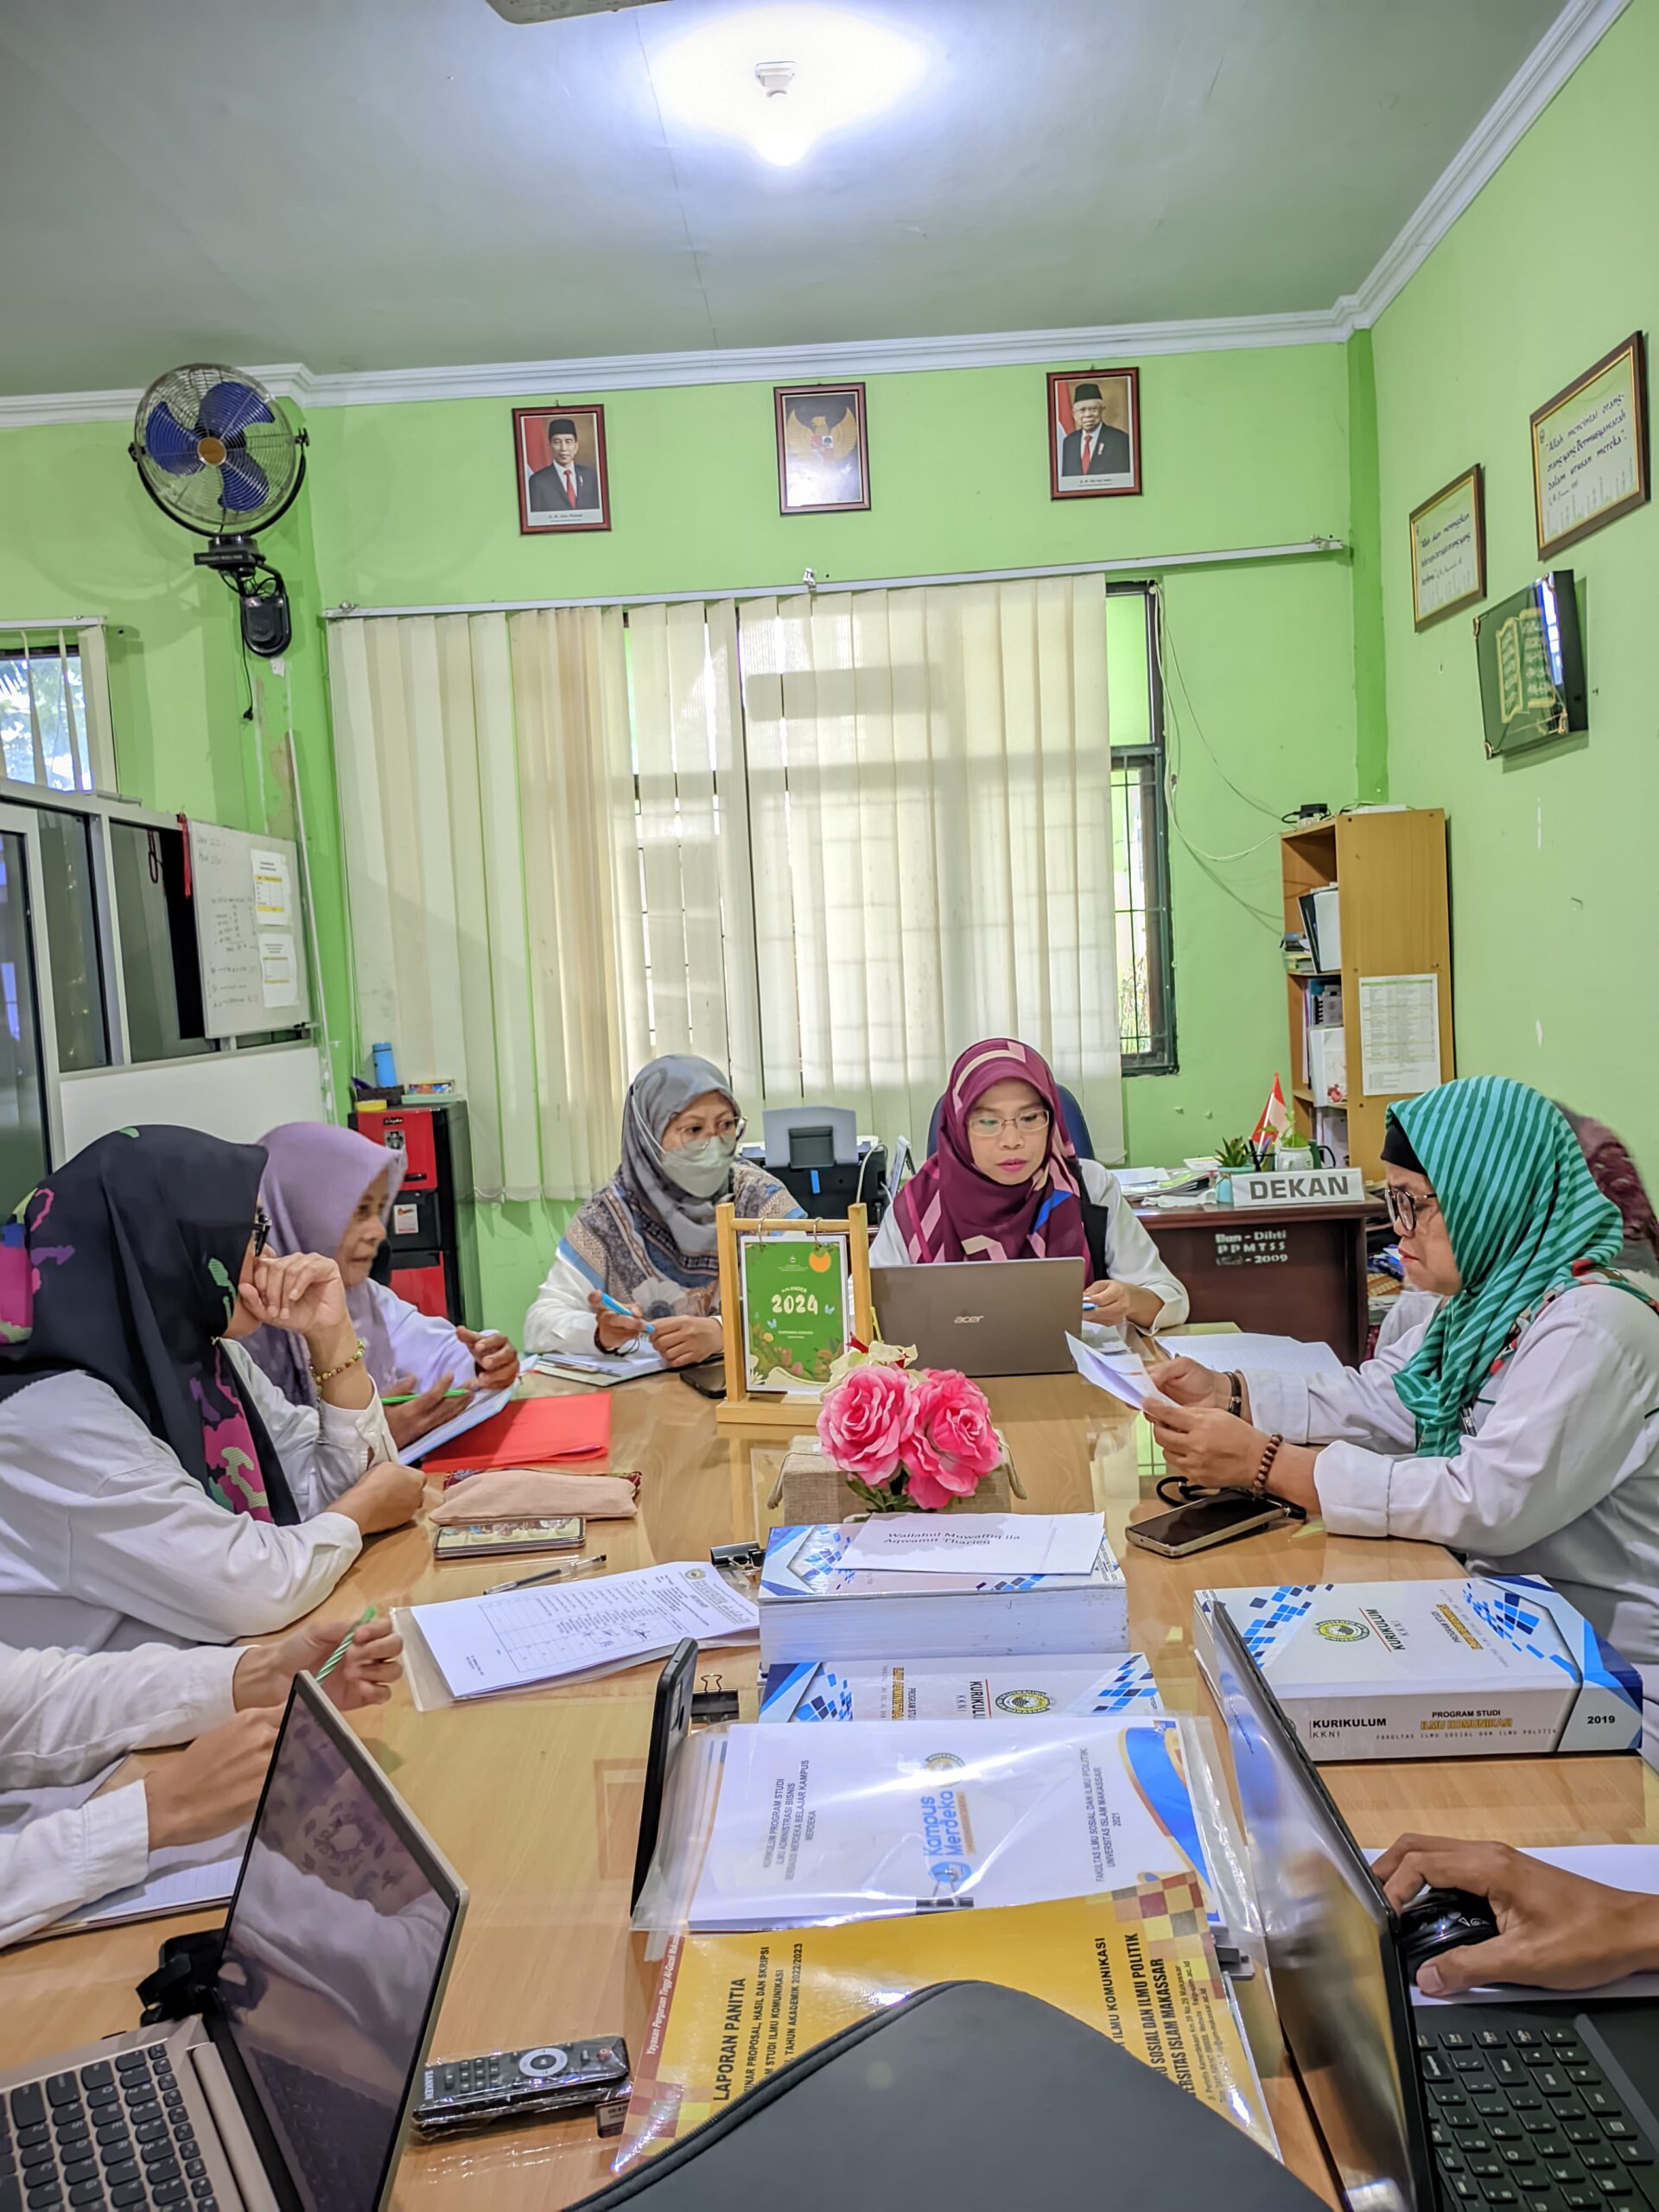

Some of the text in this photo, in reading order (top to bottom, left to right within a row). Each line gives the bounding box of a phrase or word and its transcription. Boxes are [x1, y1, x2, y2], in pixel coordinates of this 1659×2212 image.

[1249, 1176, 1349, 1200] DEKAN
[1254, 1254, 1288, 1264] 2009
[772, 1294, 818, 1315] 2024
[954, 1314, 984, 1325] acer
[1365, 1608, 1406, 1650] KURIKULUM
[1390, 1620, 1410, 1637] KKNI
[907, 1688, 917, 1708] PROGRAM
[956, 1694, 967, 1712] KKNI
[969, 1681, 986, 1719] KURIKULU
[1313, 1718, 1387, 1728] KURIKULUM
[1586, 1715, 1616, 1725] 2019
[774, 1778, 785, 1799] STUDI
[798, 1759, 810, 1790] KAMPUS
[785, 1783, 796, 1805] BISNIS
[796, 1791, 807, 1823] BELAJAR
[769, 1801, 782, 1834] PROGRAM
[779, 1807, 793, 1850] ADMINISTRASI
[804, 1810, 817, 1840] MERDEKA
[920, 1796, 944, 1857] Kampus
[938, 1790, 963, 1856] Merdeka
[1079, 1748, 1105, 1882] FAKULTAS ILMU SOSIAL DAN ILMU POLITIK
[1093, 1767, 1116, 1868] UNIVERSITAS ISLAM MAKASSAR
[1111, 1812, 1122, 1827] 2021
[791, 1824, 803, 1853] MERDEKA
[758, 1947, 770, 1979] SKRIPSI
[791, 1942, 803, 1984] 2022/2023
[1125, 1933, 1144, 1978] POLITIK
[658, 1978, 672, 1996] Tinggi
[755, 1980, 766, 1996] DAN
[770, 1969, 785, 2018] KOMUNIKASI
[1095, 1937, 1124, 2038] ILMU KOMUNIKASI
[1134, 1980, 1152, 2006] ILMU
[1174, 1966, 1187, 1997] Makassar
[652, 1996, 667, 2028] Perguruan
[753, 1998, 766, 2020] HASIL
[788, 1986, 800, 2026] AKADEMIK
[1139, 2009, 1157, 2028] DAN
[645, 2029, 661, 2055] Yayasan
[713, 1978, 746, 2101] LAPORAN PANITIA
[768, 2021, 779, 2040] ILMU
[785, 2028, 796, 2055] TAHUN
[1150, 1958, 1197, 2096] ERSITAS ISLAM MAKASSAR
[747, 2022, 764, 2066] PROPOSAL,
[766, 2042, 778, 2066] STUDI
[1147, 2031, 1166, 2063] SOSIAL
